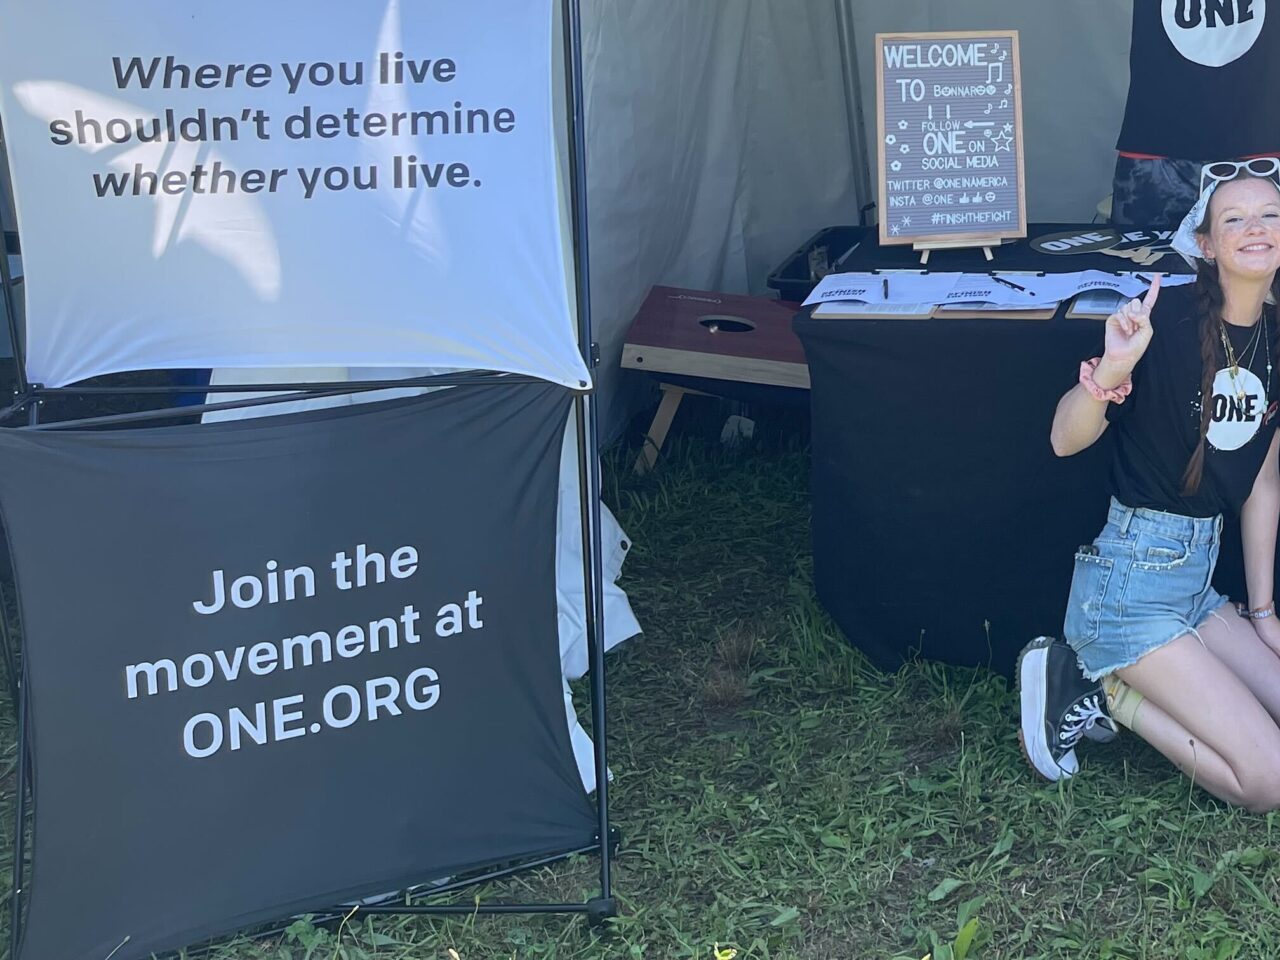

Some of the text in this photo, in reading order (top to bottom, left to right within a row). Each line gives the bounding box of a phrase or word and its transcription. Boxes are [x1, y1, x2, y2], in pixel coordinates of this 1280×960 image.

[884, 43, 988, 69] WELCOME
[111, 52, 457, 94] Where you live
[896, 79, 926, 103] TO
[49, 101, 516, 146] shouldn't determine
[922, 121, 960, 132] FOLLOW
[923, 130, 985, 155] ONE ON
[921, 155, 999, 170] SOCIAL MEDIA
[93, 155, 482, 200] whether you live.
[887, 176, 1007, 191] TWITTER @ONEINAMERICA
[890, 193, 953, 207] INSTA @ONE
[931, 210, 1012, 225] #FINISHTHEFIGHT
[1040, 232, 1112, 251] ONE
[1211, 393, 1258, 422] ONE
[192, 543, 418, 615] Join the
[125, 590, 483, 699] movement at
[182, 667, 442, 759] ONE.ORG
